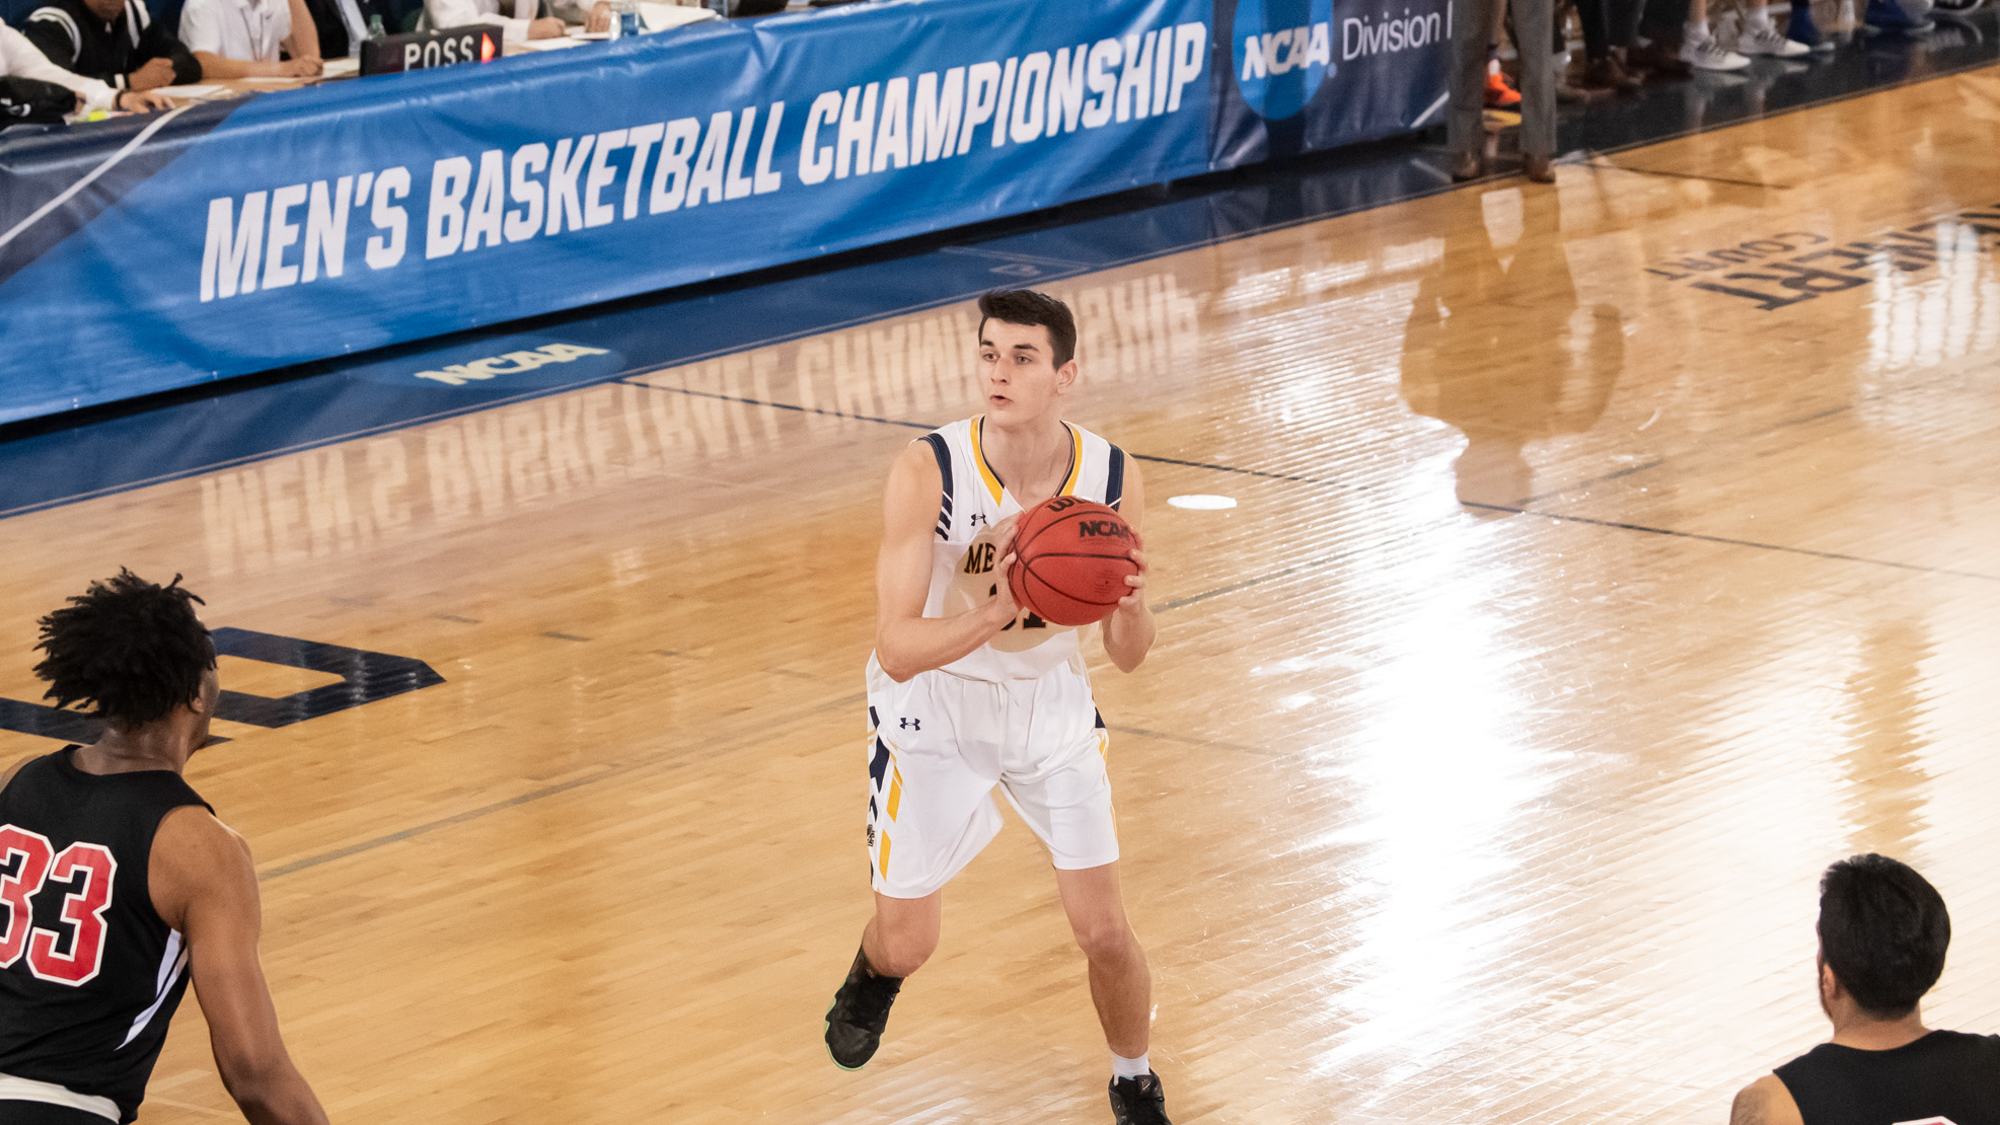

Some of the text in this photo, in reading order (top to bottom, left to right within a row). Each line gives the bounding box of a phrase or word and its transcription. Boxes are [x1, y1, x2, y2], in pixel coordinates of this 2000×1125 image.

[404, 35, 475, 71] POSS
[1241, 22, 1330, 81] NCAA
[1343, 7, 1441, 61] Division
[200, 21, 1207, 301] MEN'S BASKETBALL CHAMPIONSHIP
[414, 343, 611, 385] NCAA
[1079, 520, 1130, 540] NCAA
[0, 823, 118, 987] 33
